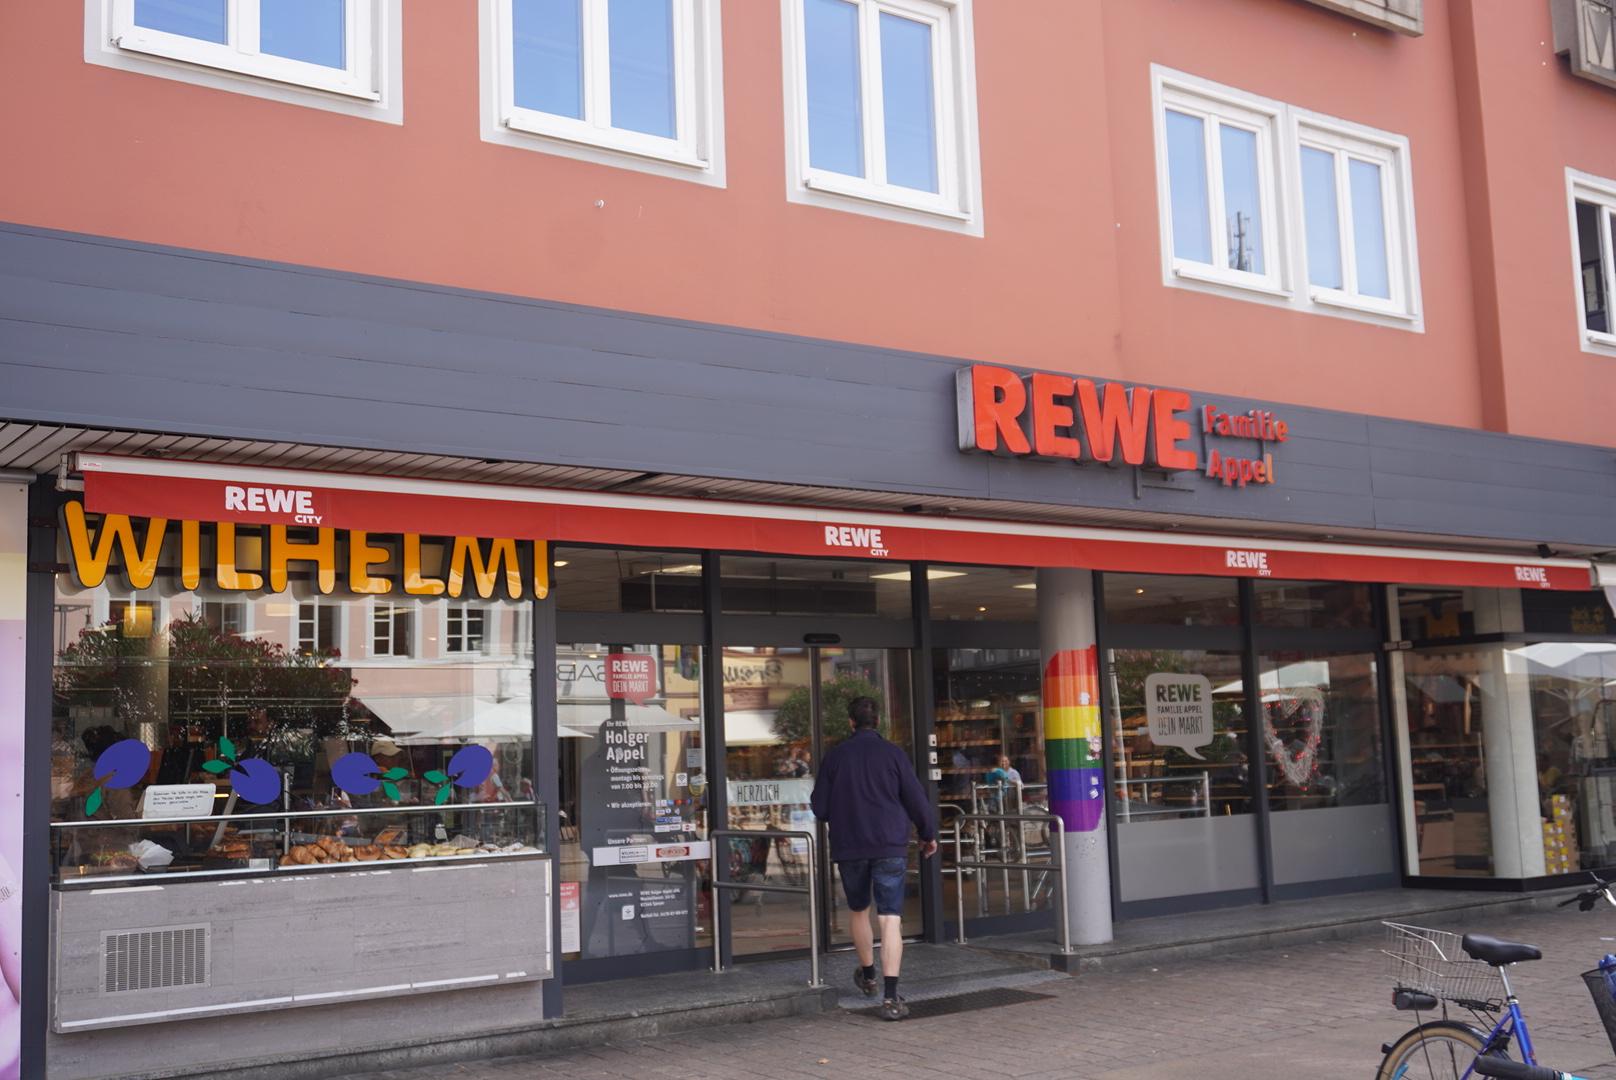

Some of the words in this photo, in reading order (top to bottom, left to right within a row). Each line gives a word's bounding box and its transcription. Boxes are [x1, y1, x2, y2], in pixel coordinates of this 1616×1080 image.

[959, 364, 1198, 470] REWE
[1203, 405, 1289, 442] Familie
[1207, 448, 1275, 488] Appel
[225, 486, 314, 514] REWE
[294, 514, 322, 524] CITY
[824, 525, 884, 548] REWE
[62, 500, 548, 599] WILHELMI
[870, 548, 889, 556] CITY
[1226, 550, 1268, 569] REWE
[1514, 566, 1548, 582] REWE
[612, 660, 648, 672] REWE
[1156, 684, 1203, 702] REWE
[1157, 705, 1182, 714] FAMILIE
[1183, 705, 1203, 714] APPEL
[1158, 717, 1177, 736] DEIN
[1178, 716, 1204, 736] MARKT
[606, 730, 650, 747] Holger
[606, 745, 645, 763] Appel
[736, 783, 780, 803] HERZLICH
